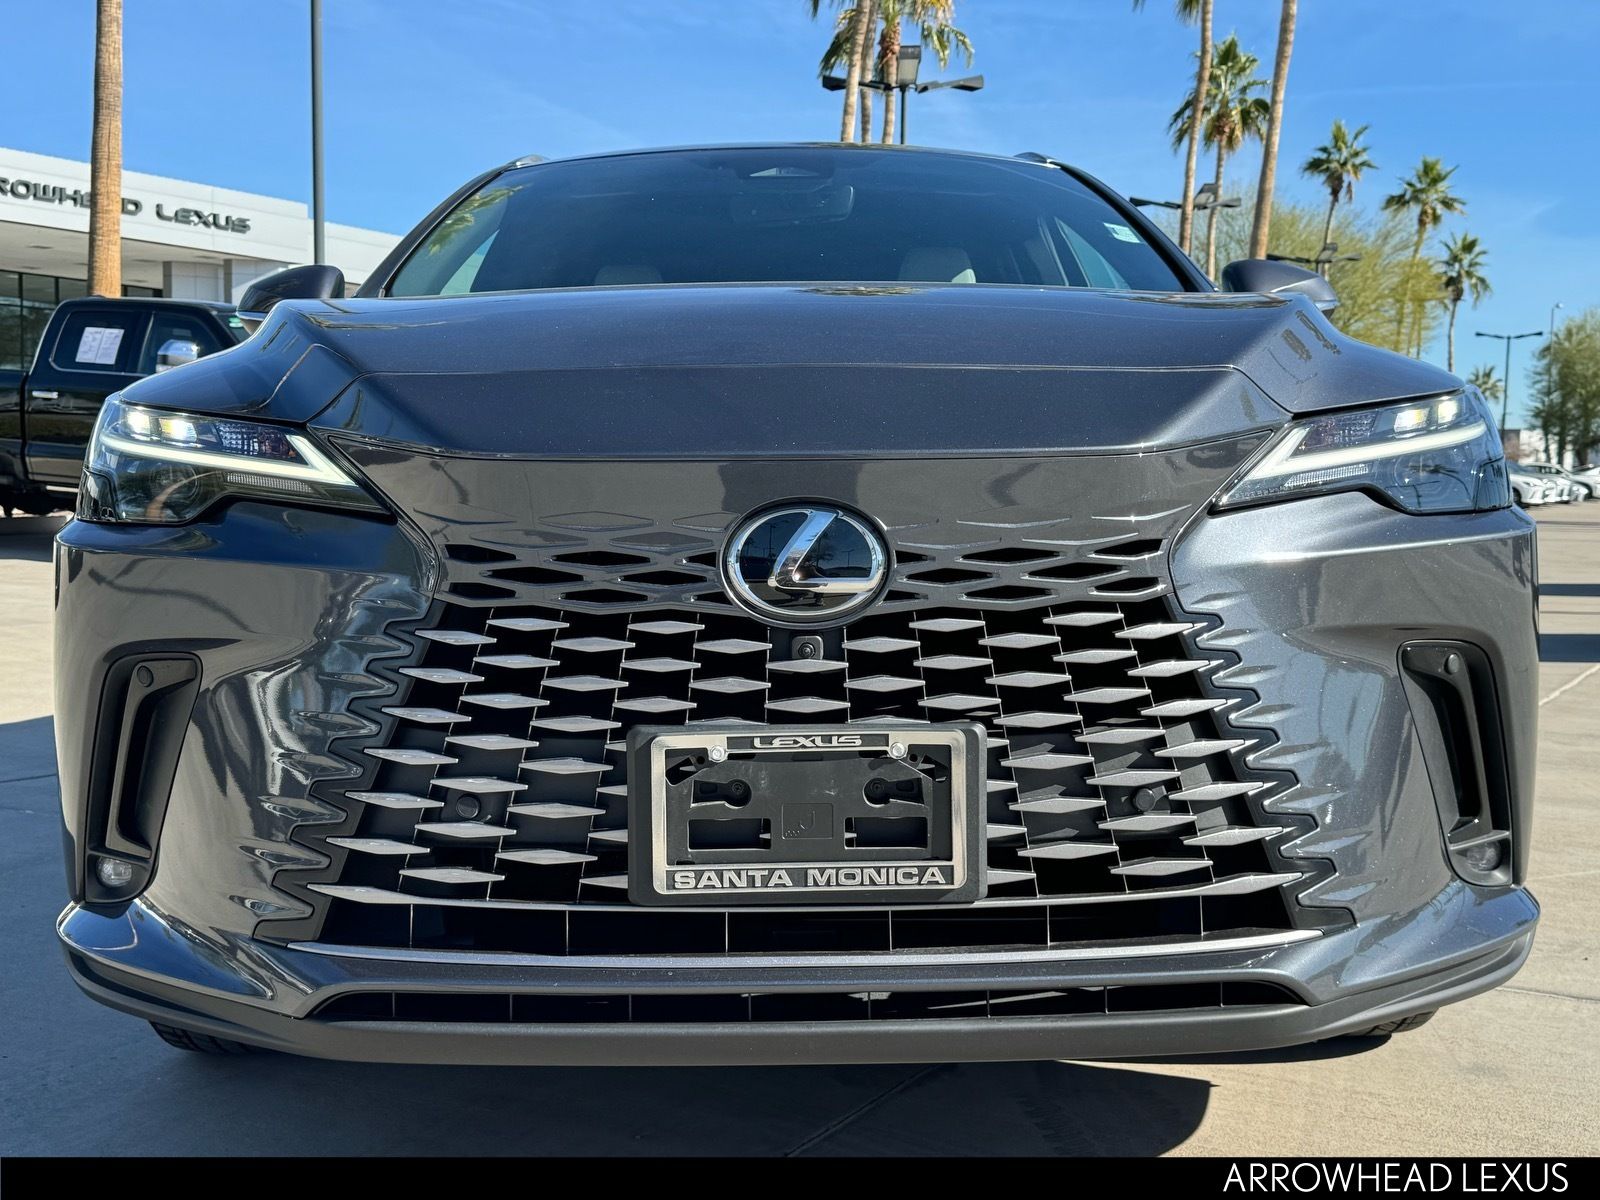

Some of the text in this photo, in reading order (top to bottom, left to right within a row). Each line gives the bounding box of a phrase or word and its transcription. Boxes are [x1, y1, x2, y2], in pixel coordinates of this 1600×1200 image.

[0, 176, 251, 234] ROWHED LEXUS
[753, 735, 863, 748] LEXUS
[674, 867, 946, 889] SANTA MONICA
